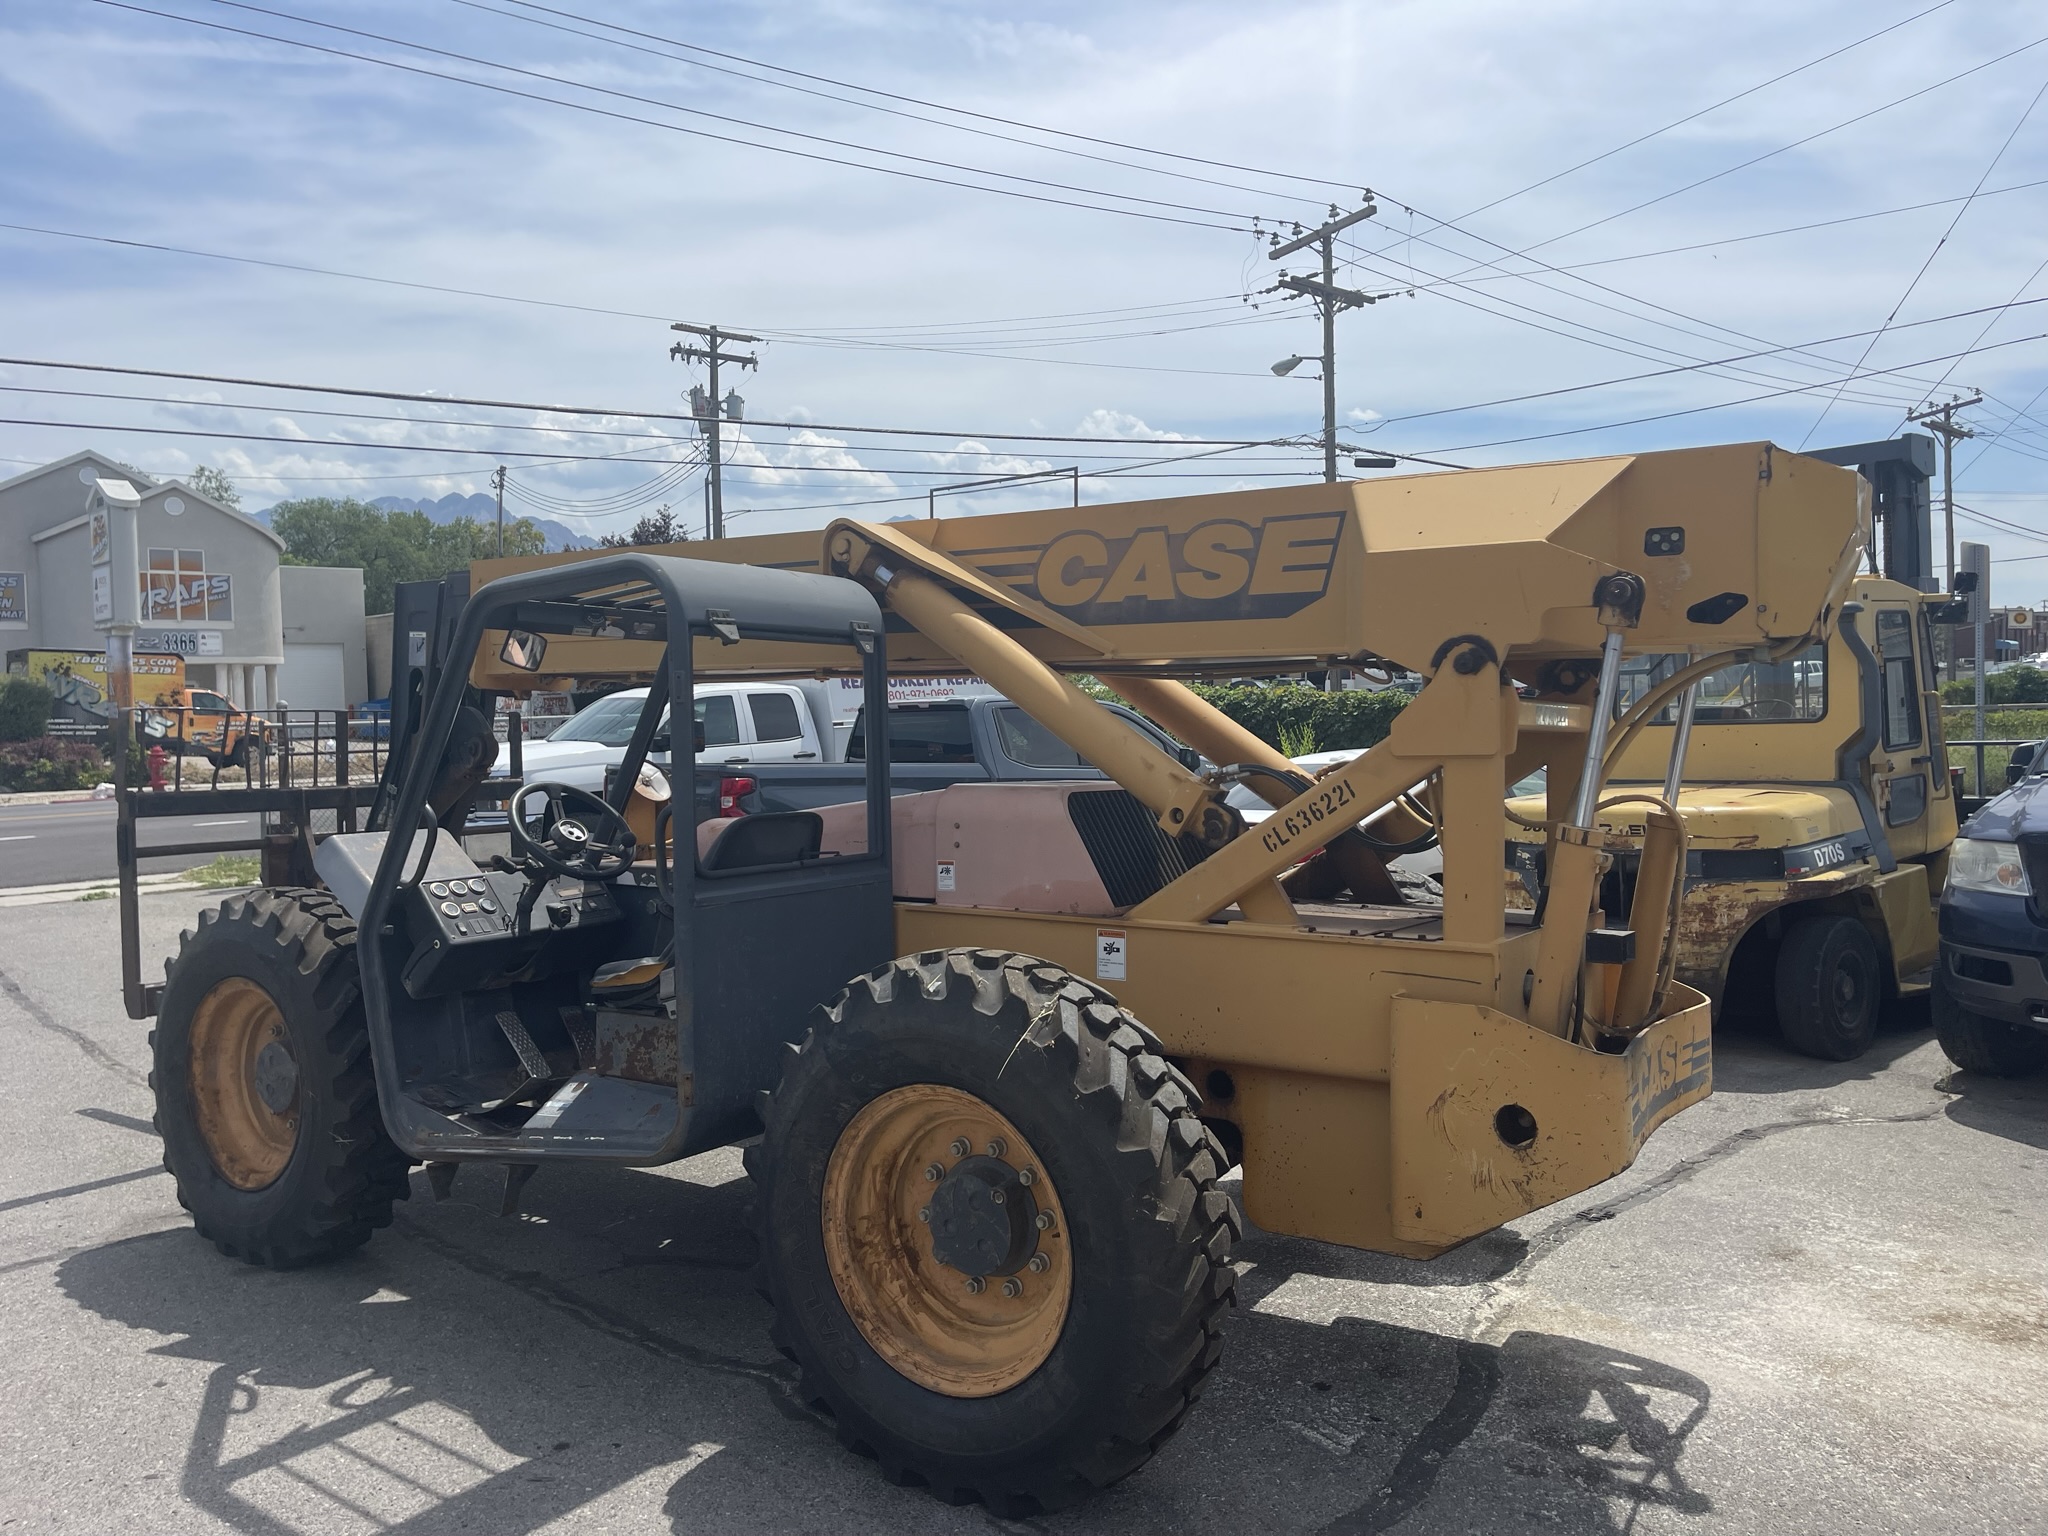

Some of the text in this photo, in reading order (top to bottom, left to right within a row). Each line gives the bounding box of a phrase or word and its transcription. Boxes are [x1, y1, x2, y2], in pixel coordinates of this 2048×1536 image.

[1037, 514, 1342, 607] CASE
[162, 631, 197, 653] 3365
[888, 677, 942, 688] ORKLIFT
[1262, 779, 1356, 853] CL636221
[1813, 842, 1845, 868] D70S
